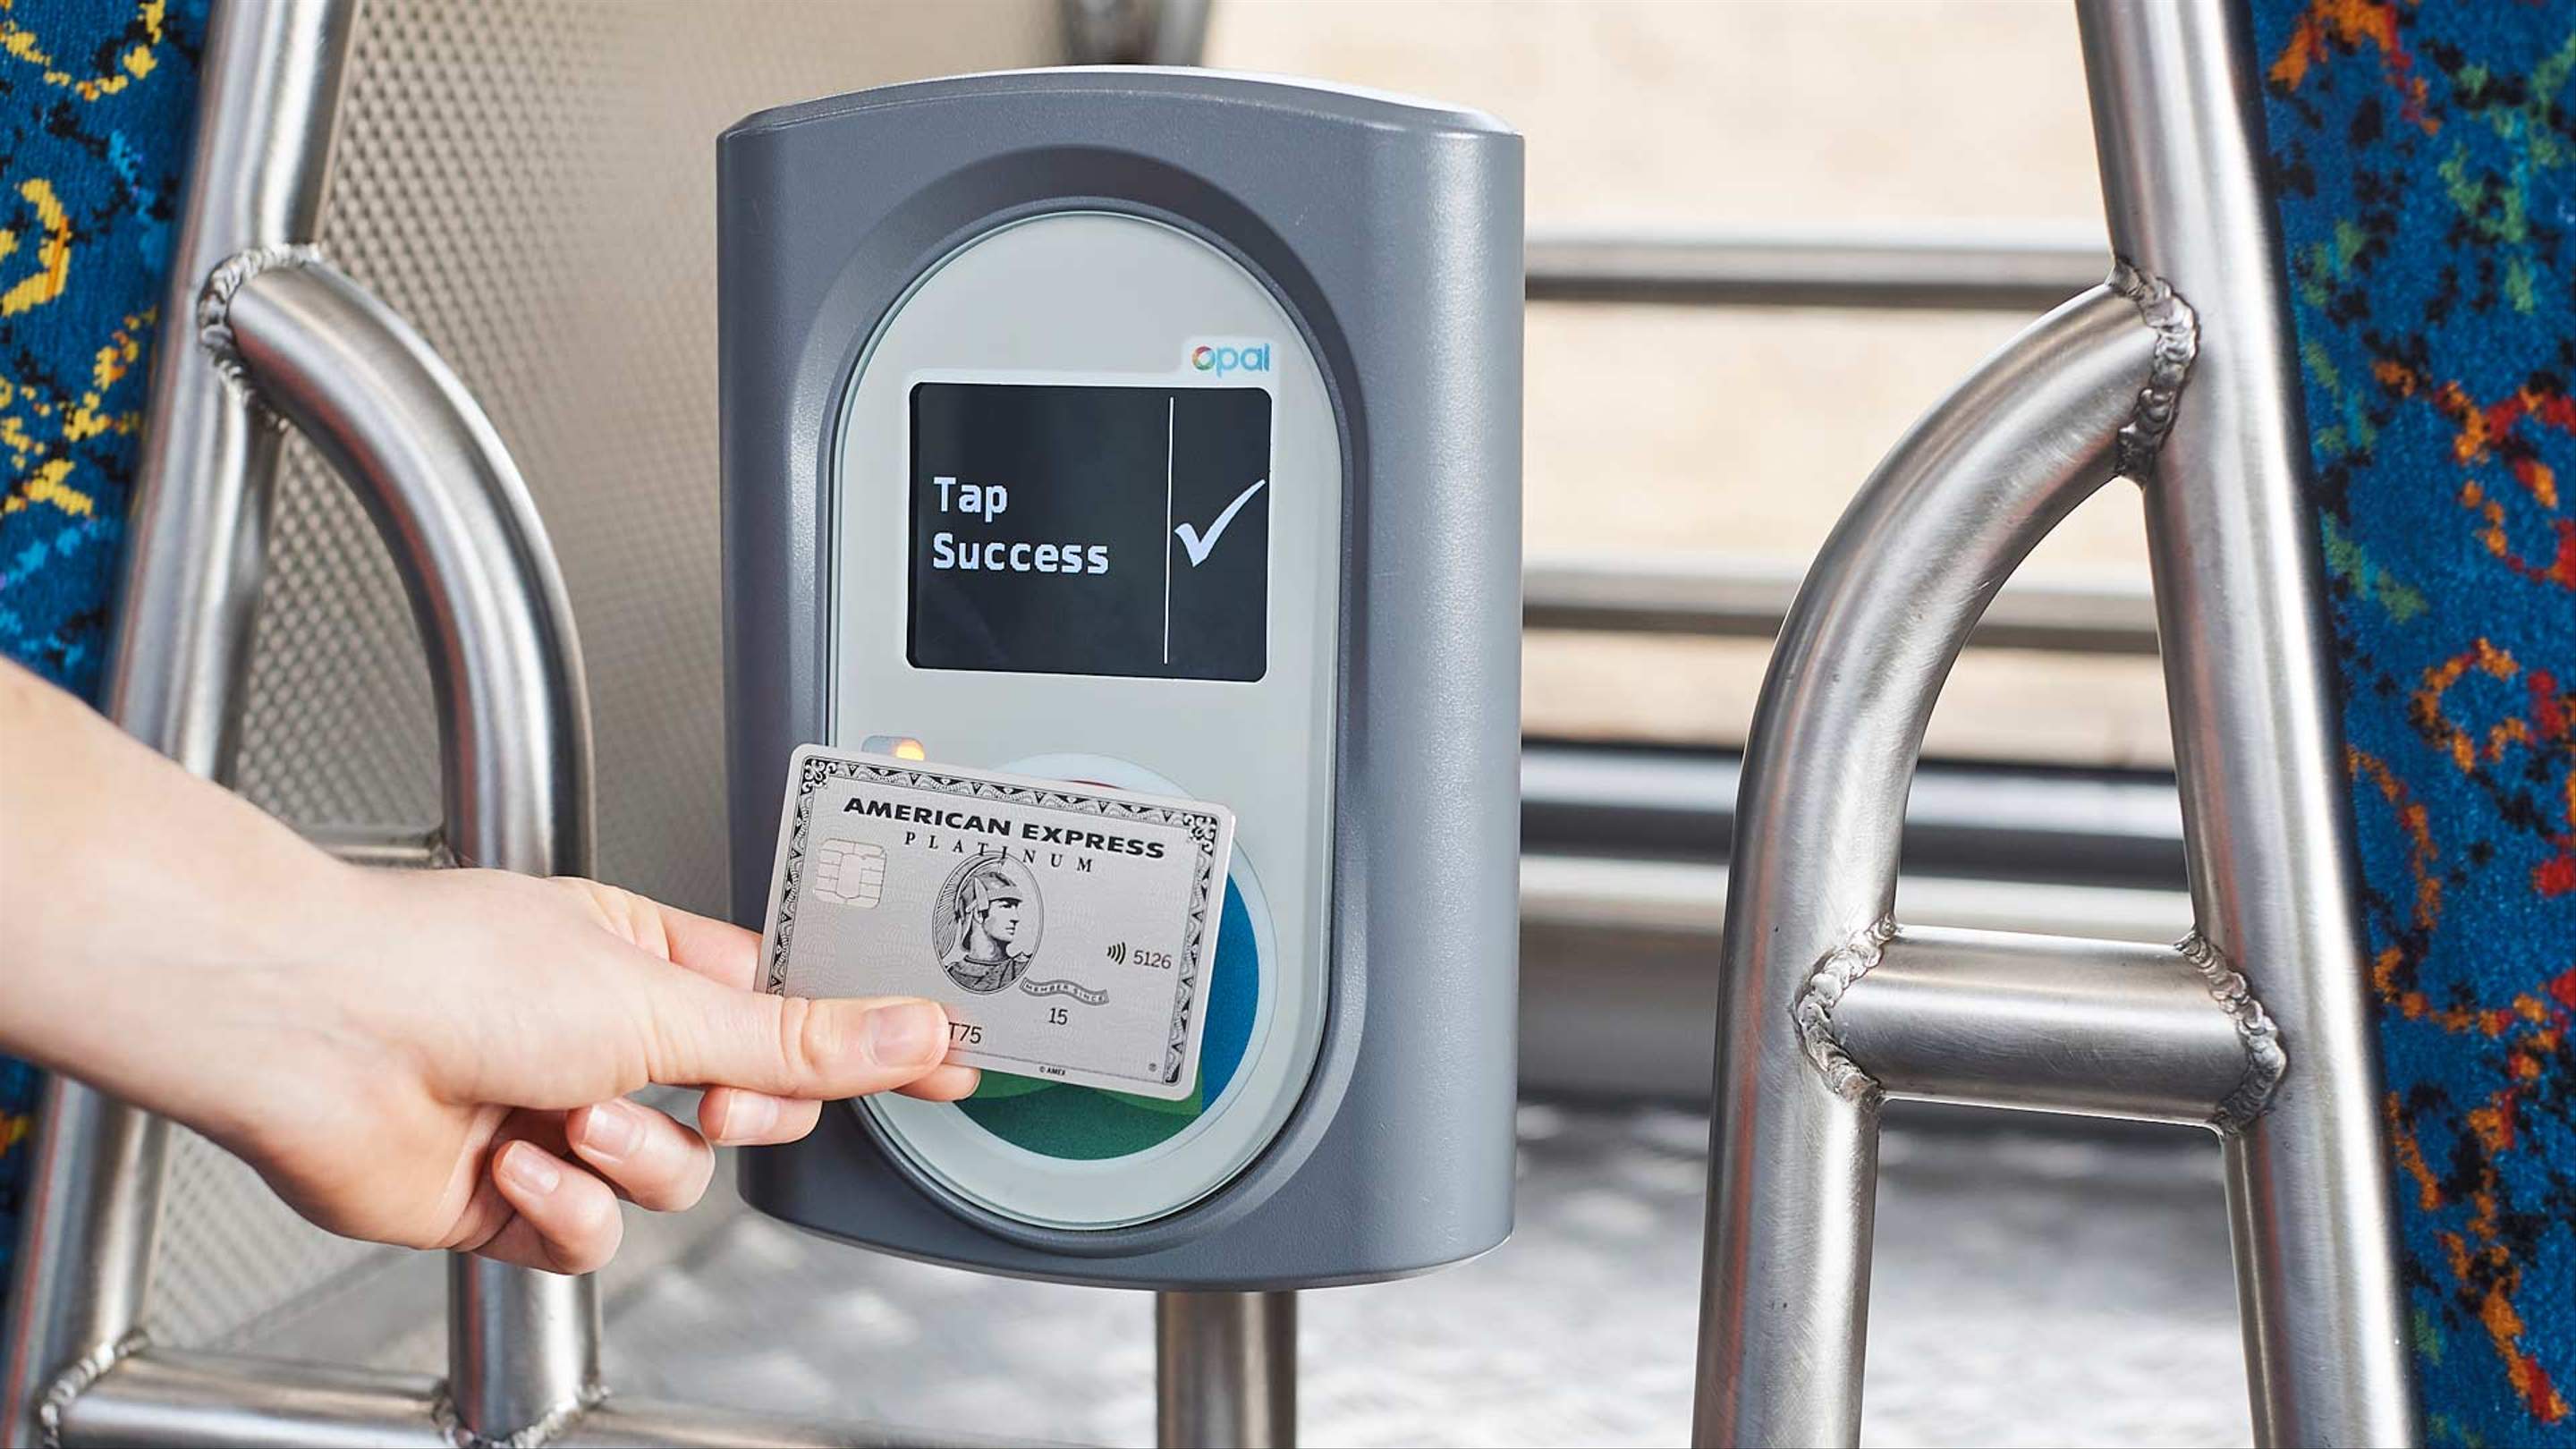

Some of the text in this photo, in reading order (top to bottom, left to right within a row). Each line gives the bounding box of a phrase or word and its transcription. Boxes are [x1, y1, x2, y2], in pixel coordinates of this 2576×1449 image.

[1191, 343, 1269, 377] opal
[932, 476, 1008, 523] Tap
[932, 532, 1109, 574] Success
[843, 797, 1165, 860] AMERICAN EXPRESS
[905, 831, 1094, 873] PLATINUM
[1133, 950, 1173, 970] 5126
[1025, 983, 1105, 1002] MEMBER SINCE
[1048, 1007, 1068, 1026] 15
